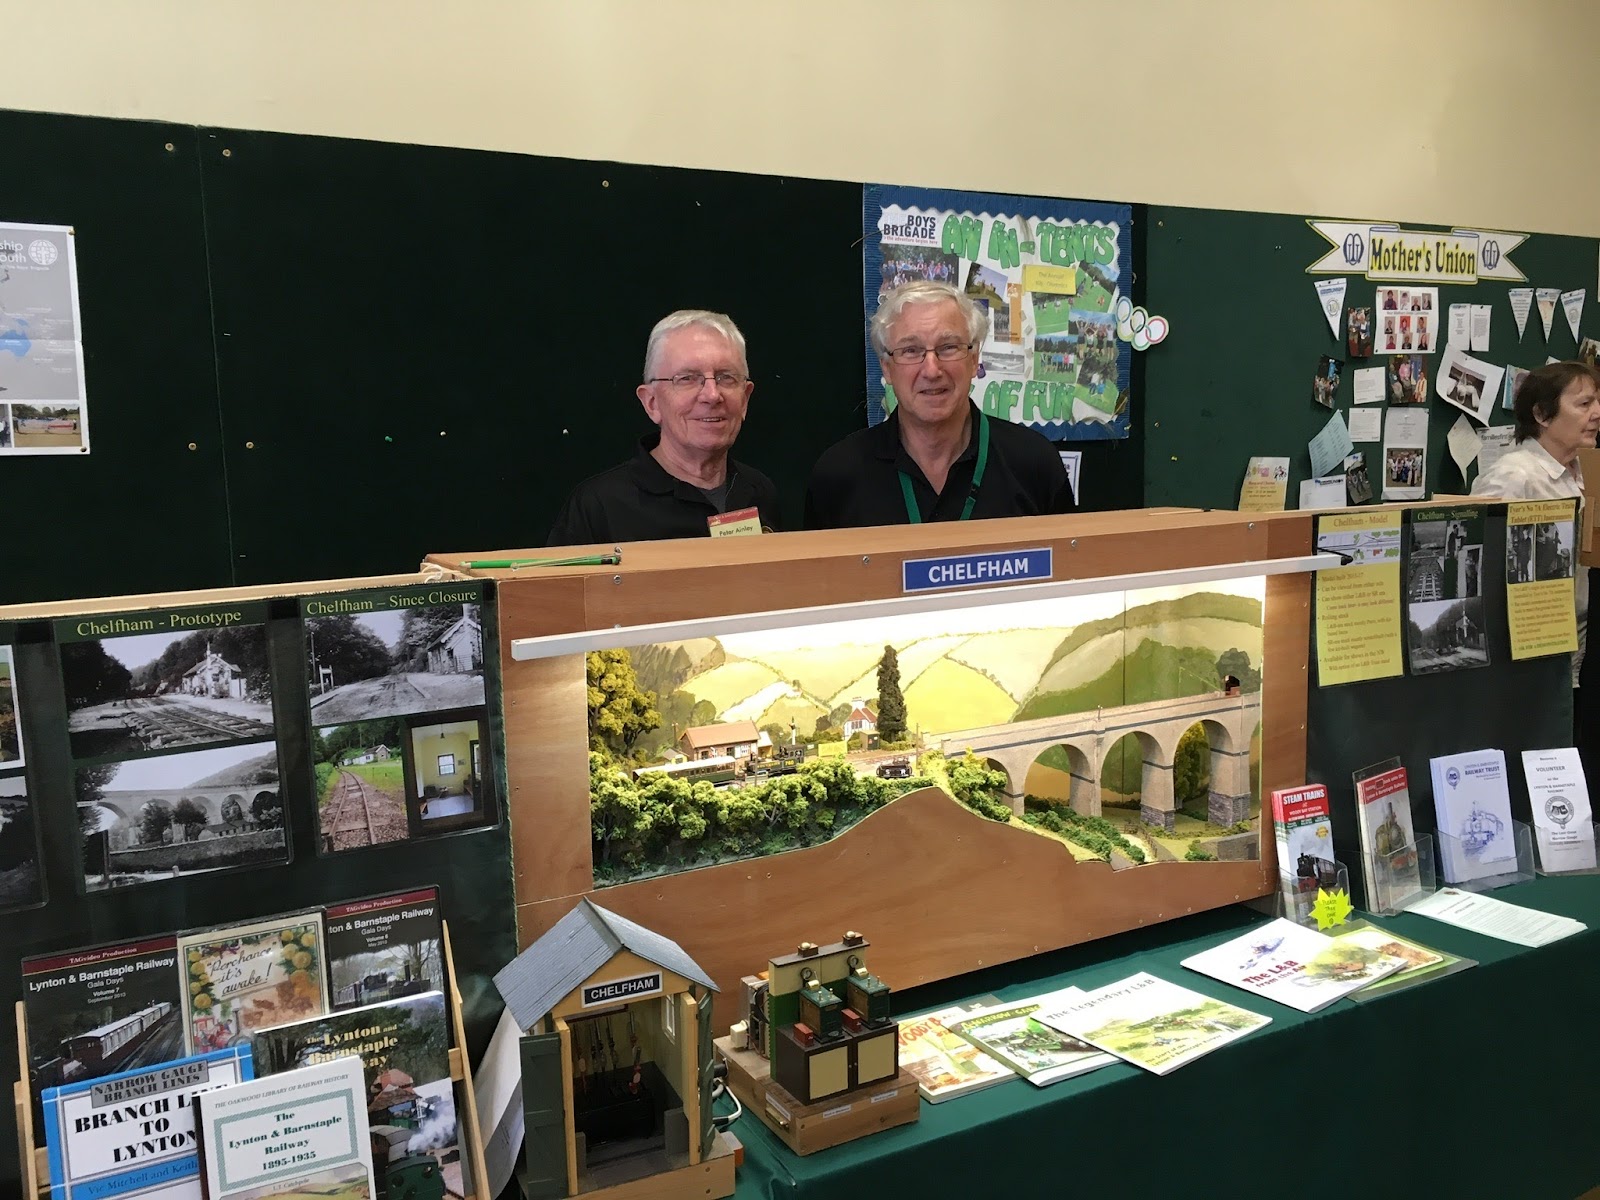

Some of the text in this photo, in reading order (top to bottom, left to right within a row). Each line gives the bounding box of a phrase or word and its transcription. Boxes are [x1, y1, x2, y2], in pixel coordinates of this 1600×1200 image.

[883, 224, 936, 240] BRIGADE
[907, 214, 936, 229] BOYS
[942, 214, 984, 262] AN
[1370, 238, 1475, 275] Mother's Union
[982, 379, 1076, 422] OF FUN
[1333, 515, 1388, 527] Chelfham Model
[1417, 512, 1445, 521] Chelfham
[1511, 516, 1527, 524] Tablet
[719, 525, 754, 537] Peter Ainley
[928, 557, 1029, 583] CHELFHAM
[306, 590, 477, 615] Chelfham Since Closure
[76, 610, 242, 636] Chelfham Prototype
[1464, 767, 1485, 776] RAILWAY
[1282, 788, 1325, 805] STEAM TRAINS
[373, 898, 403, 908] Production
[345, 907, 434, 931] & Barnstaple Railway
[376, 924, 392, 932] Days
[365, 935, 385, 943] Volume
[102, 947, 138, 958] Production
[29, 957, 175, 992] Lynton & Barnstaple Railway
[1241, 959, 1299, 984] The L&B
[1255, 977, 1279, 988] from
[1278, 971, 1295, 979] the
[87, 976, 124, 989] Gala Days
[92, 988, 115, 997] Volume
[590, 977, 654, 999] CHELFHAM
[1046, 978, 1156, 1020] The Legendary L&B
[323, 1025, 381, 1047] Lynton
[382, 1023, 398, 1033] and
[308, 1035, 398, 1065] Barnstaple
[94, 1072, 156, 1096] NARROW
[161, 1063, 206, 1080] GAUGE
[104, 1084, 158, 1103] BRANCH
[163, 1074, 201, 1090] LINES
[227, 1093, 262, 1107] OAKWOOD
[261, 1086, 288, 1099] LIBRARY
[288, 1084, 297, 1092] OF
[297, 1079, 324, 1091] RAILWAY
[323, 1073, 350, 1085] HISTORY
[74, 1097, 170, 1134] BRANCH
[273, 1111, 296, 1123] The
[139, 1117, 170, 1137] TO
[228, 1115, 342, 1149] Lynton & Barnstaple
[264, 1138, 310, 1155] Railway
[262, 1150, 317, 1171] 1895-1935
[88, 1182, 104, 1195] Vic
[107, 1169, 149, 1190] Mitchell
[150, 1167, 169, 1180] and
